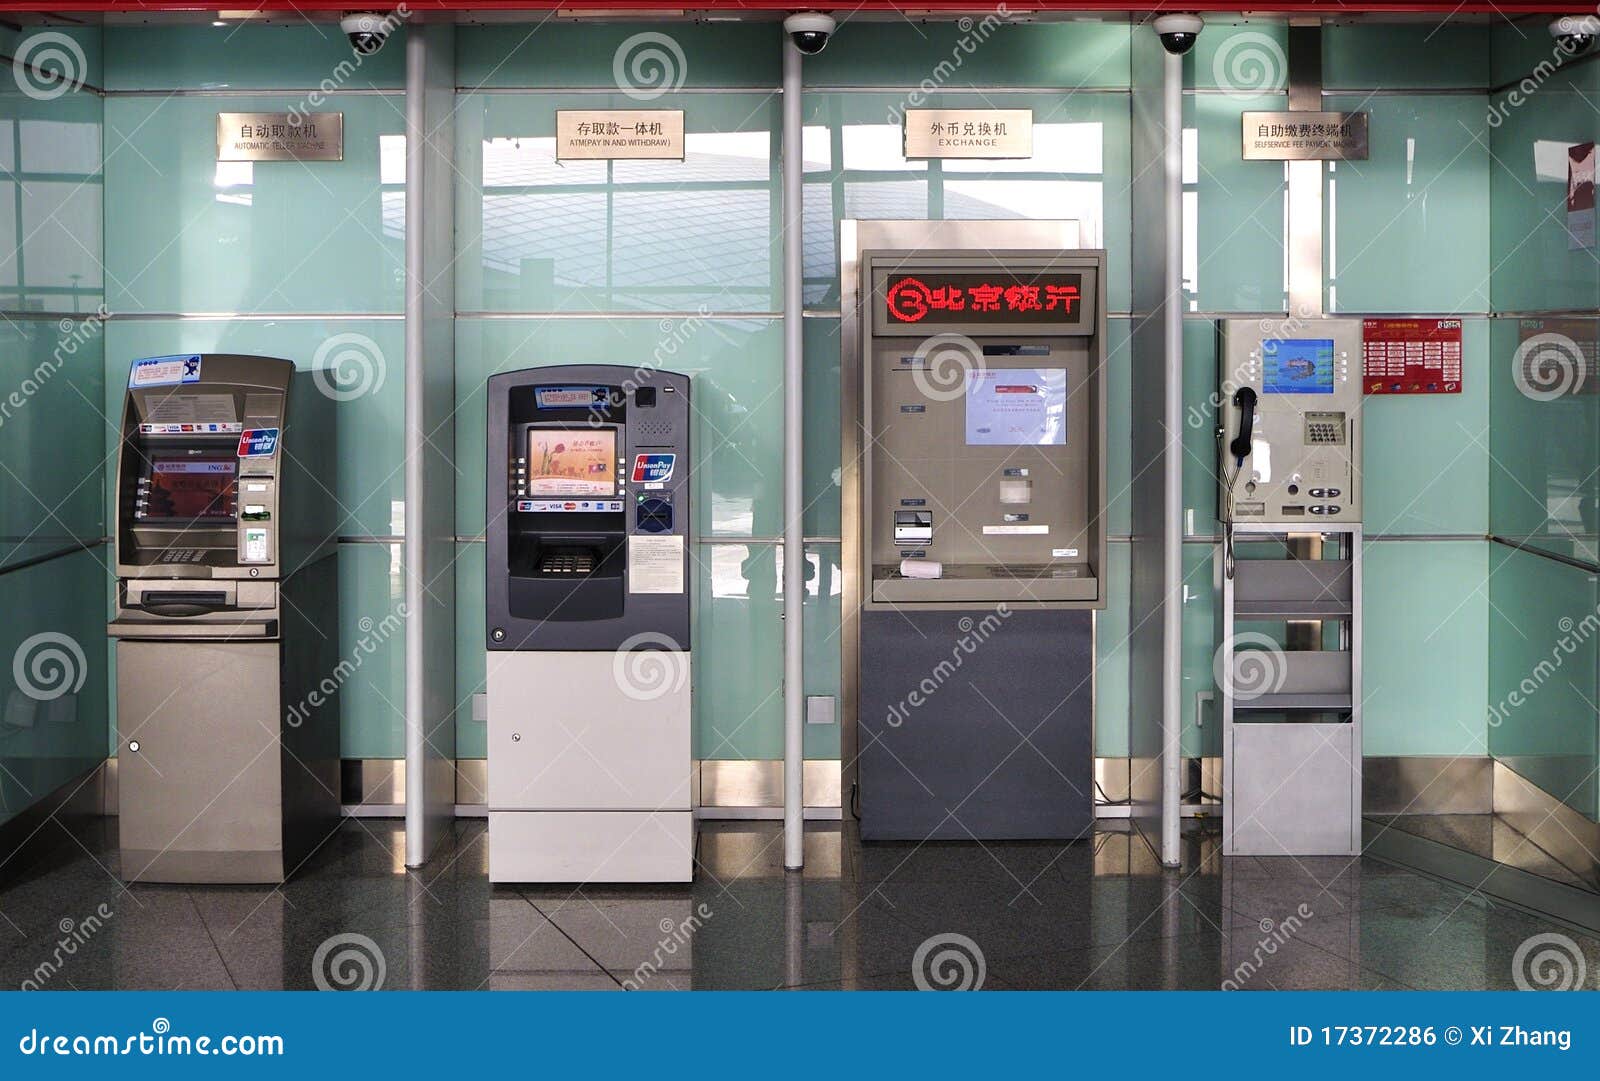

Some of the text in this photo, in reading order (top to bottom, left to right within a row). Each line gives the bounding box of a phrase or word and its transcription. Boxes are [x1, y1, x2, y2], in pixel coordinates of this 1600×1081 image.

[241, 124, 317, 138] 自动取款机
[577, 121, 663, 136] 存取款一体机
[930, 122, 1007, 136] 外币兑换机
[1258, 124, 1352, 138] 自助缴费终端机
[234, 141, 270, 150] AUTOMATIC
[569, 138, 671, 147] ATM(PAY IN AND WITHDRAW)
[938, 138, 998, 147] EXCHANGE
[1292, 140, 1304, 149] FEE
[929, 283, 1081, 314] 北京银行
[241, 434, 276, 445] UnionPay
[637, 460, 671, 470] UnionPay
